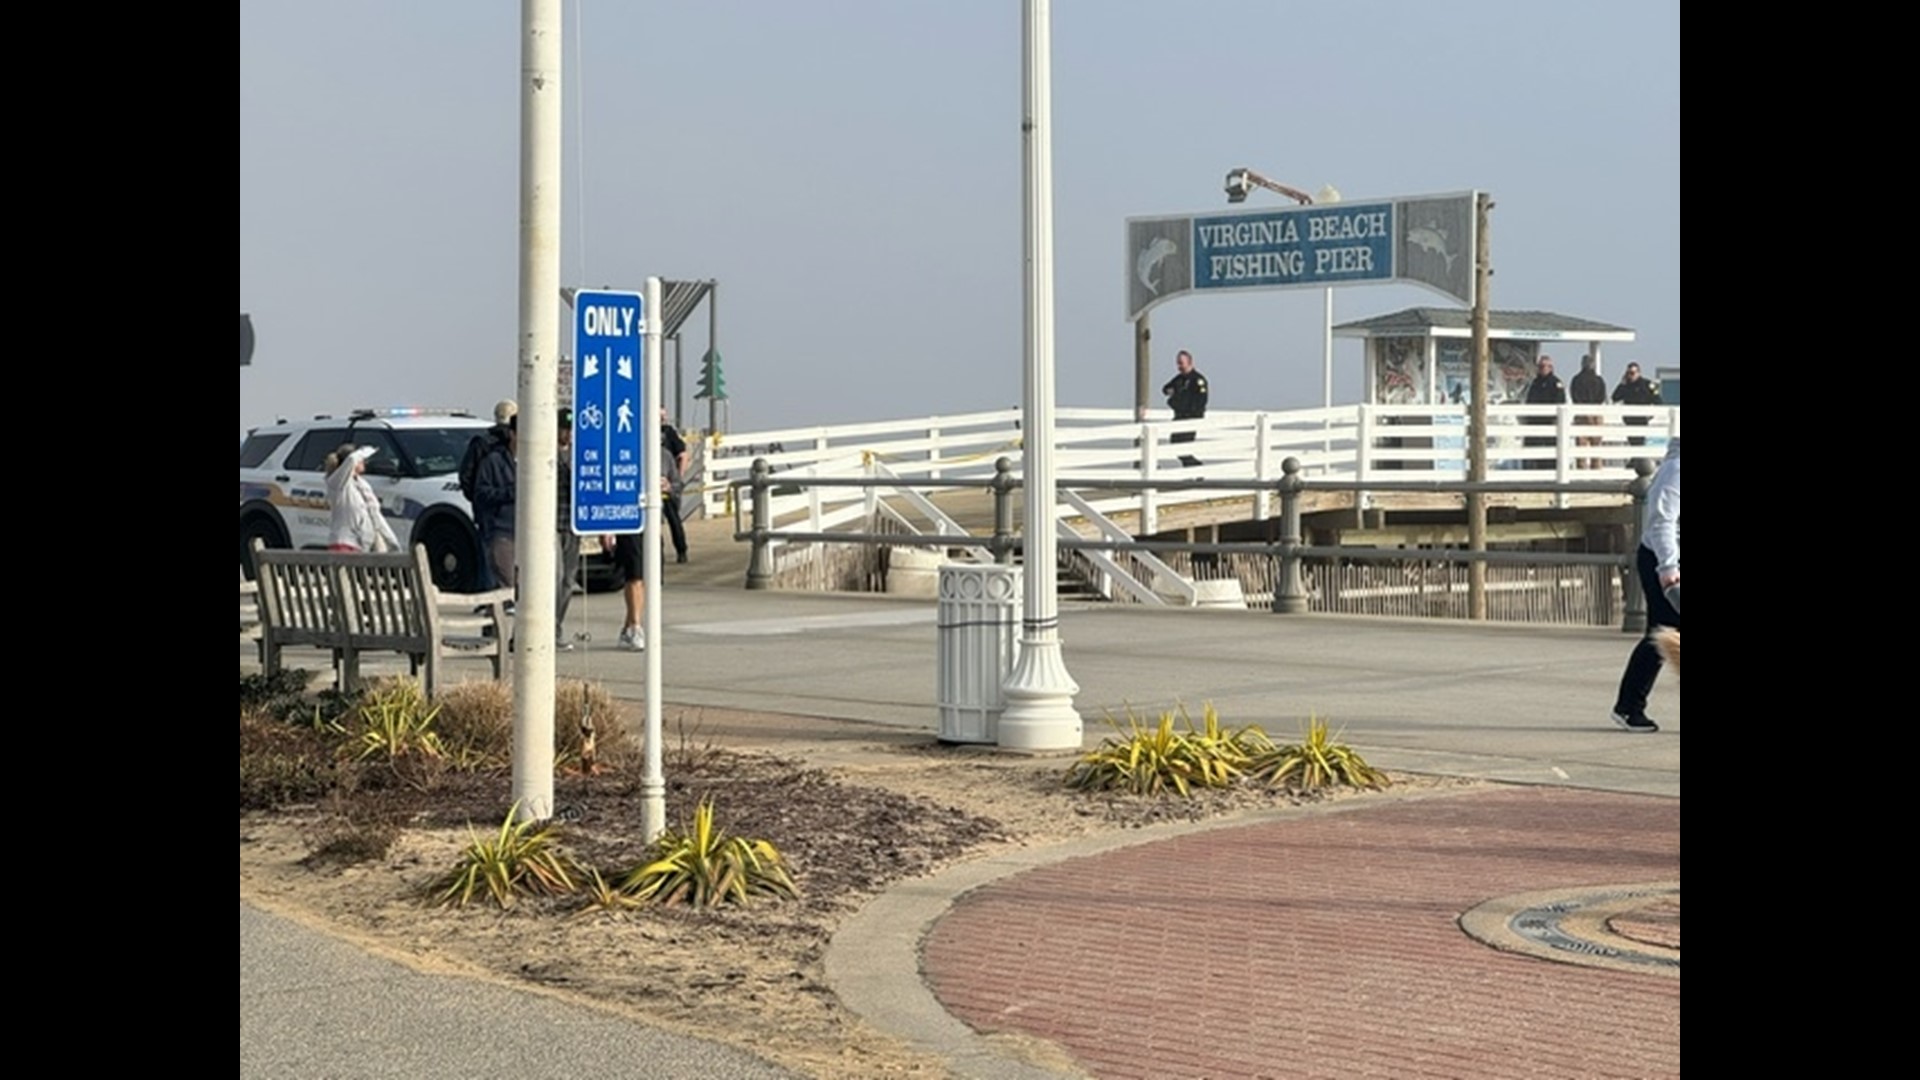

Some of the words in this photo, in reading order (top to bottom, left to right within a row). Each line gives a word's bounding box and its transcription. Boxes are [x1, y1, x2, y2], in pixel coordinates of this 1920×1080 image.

[1199, 219, 1299, 248] VIRGINIA
[1308, 213, 1386, 241] BEACH
[1210, 250, 1305, 280] FISHING
[1315, 247, 1374, 275] PIER
[584, 306, 634, 337] ONLY
[584, 449, 598, 461] ON
[619, 449, 631, 461] ON
[580, 465, 602, 477] BIKE
[612, 464, 638, 476] BOARD
[579, 481, 603, 491] PATH
[615, 481, 635, 491] WALK
[578, 505, 589, 520] NO
[591, 504, 639, 521] SKATEBOARDS
